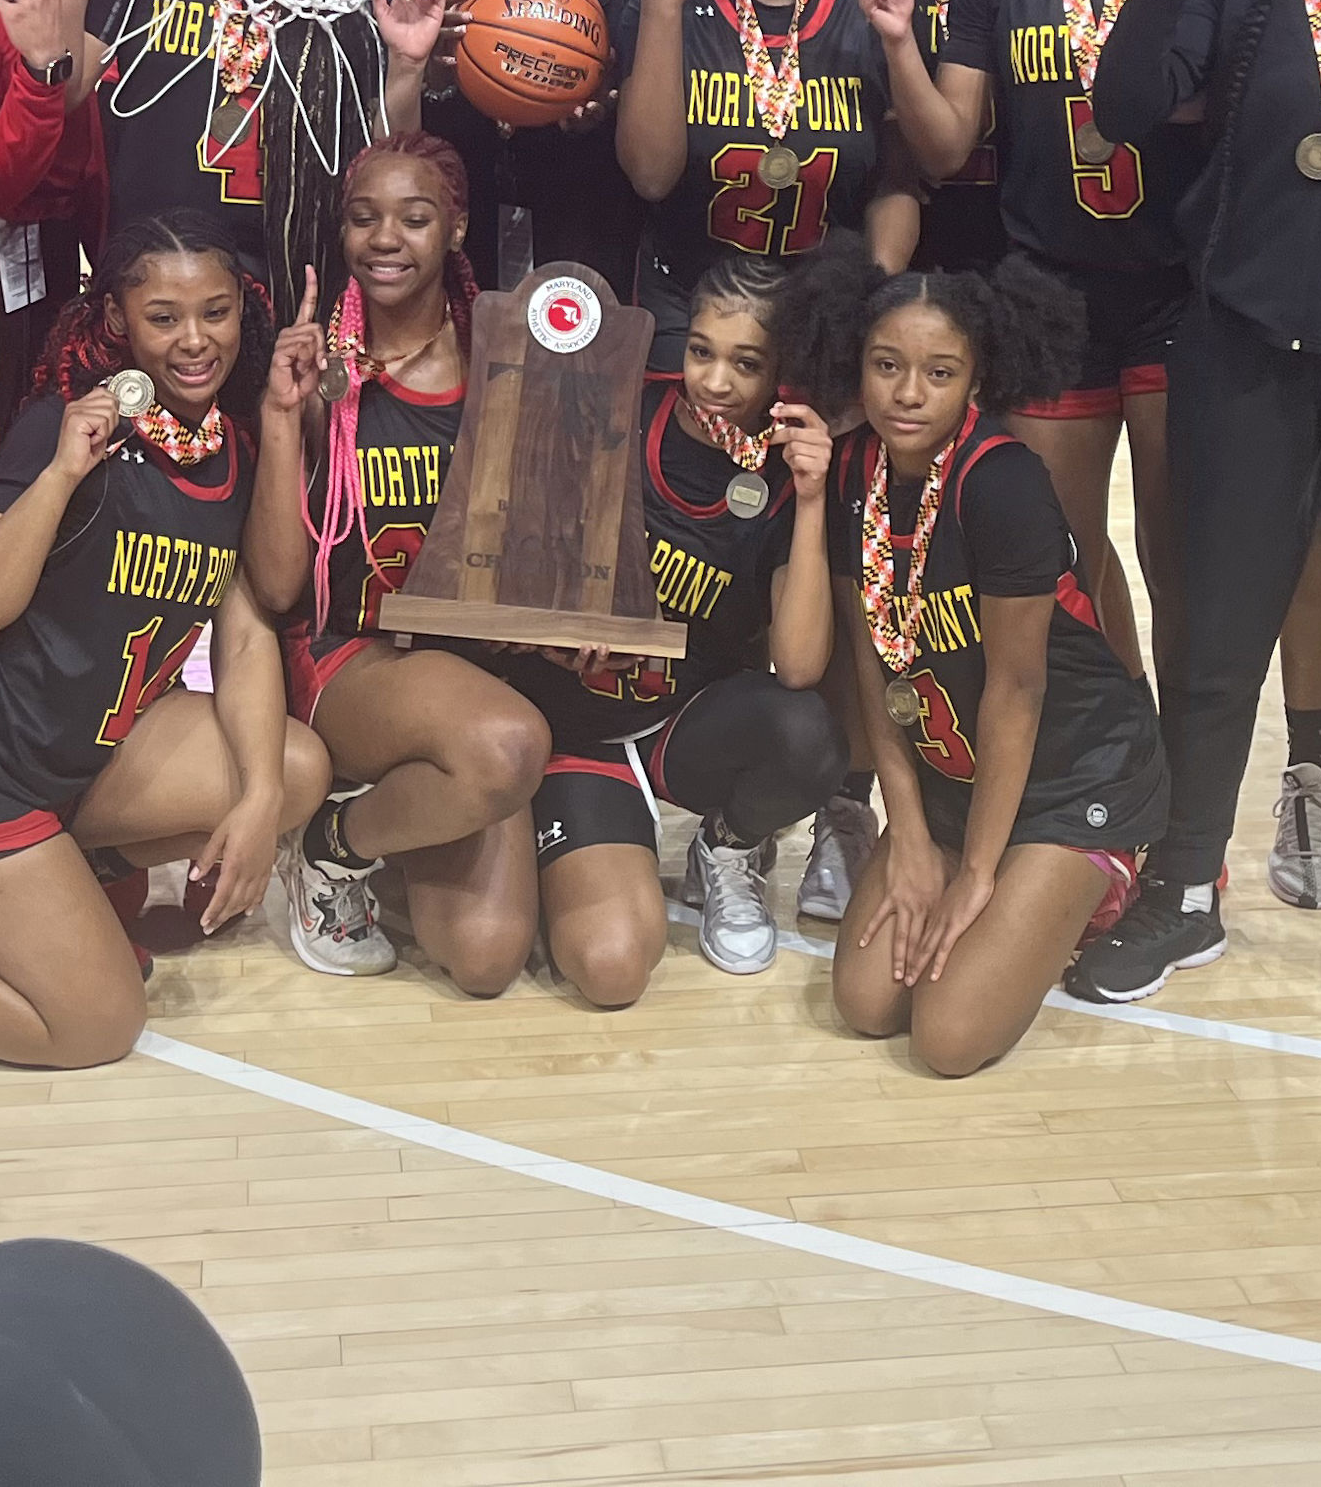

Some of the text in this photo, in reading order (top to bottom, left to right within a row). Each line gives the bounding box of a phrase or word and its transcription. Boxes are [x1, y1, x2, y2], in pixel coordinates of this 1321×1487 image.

[1010, 23, 1075, 86] NORT
[686, 69, 755, 129] NORT
[1065, 96, 1145, 220] 5
[708, 142, 839, 256] 21
[545, 280, 593, 301] MARYLAND
[106, 529, 204, 604] NORTH
[915, 584, 982, 658] OINT
